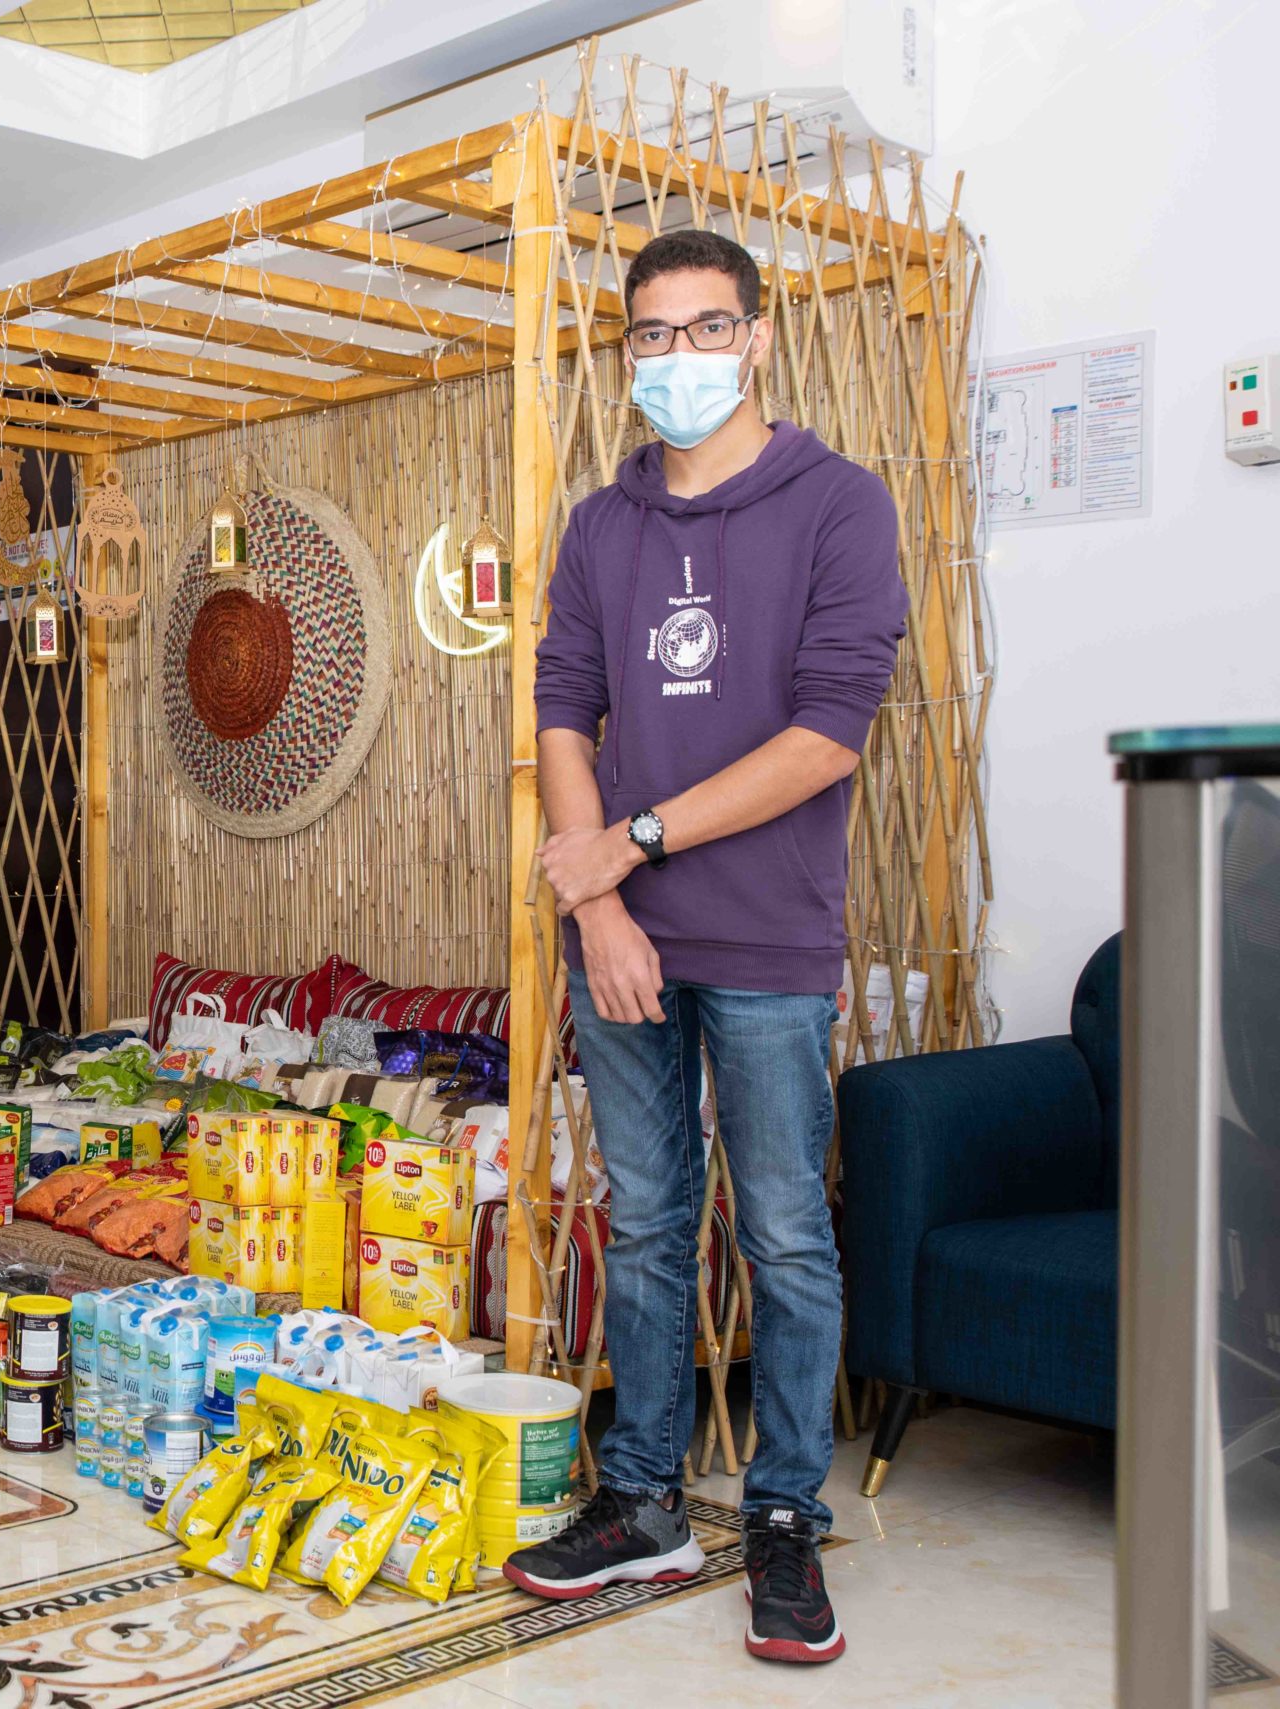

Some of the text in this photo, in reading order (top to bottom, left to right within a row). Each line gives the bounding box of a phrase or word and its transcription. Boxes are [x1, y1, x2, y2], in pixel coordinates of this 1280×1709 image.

[987, 365, 1024, 379] VACUATION
[684, 556, 693, 594] Explore
[647, 628, 658, 660] Strong
[662, 680, 712, 696] INFINITE
[206, 1132, 221, 1144] Lipton
[396, 1163, 420, 1175] Lipton
[392, 1190, 421, 1202] YELLOW
[394, 1201, 417, 1213] LABEL
[208, 1219, 223, 1231] Lipton
[393, 1261, 417, 1274] Lipton
[390, 1289, 418, 1301] YELLOW
[392, 1299, 415, 1311] LABEL
[152, 1388, 169, 1405] Milk
[340, 1449, 405, 1495] NIDO
[770, 1508, 794, 1523] NIKE
